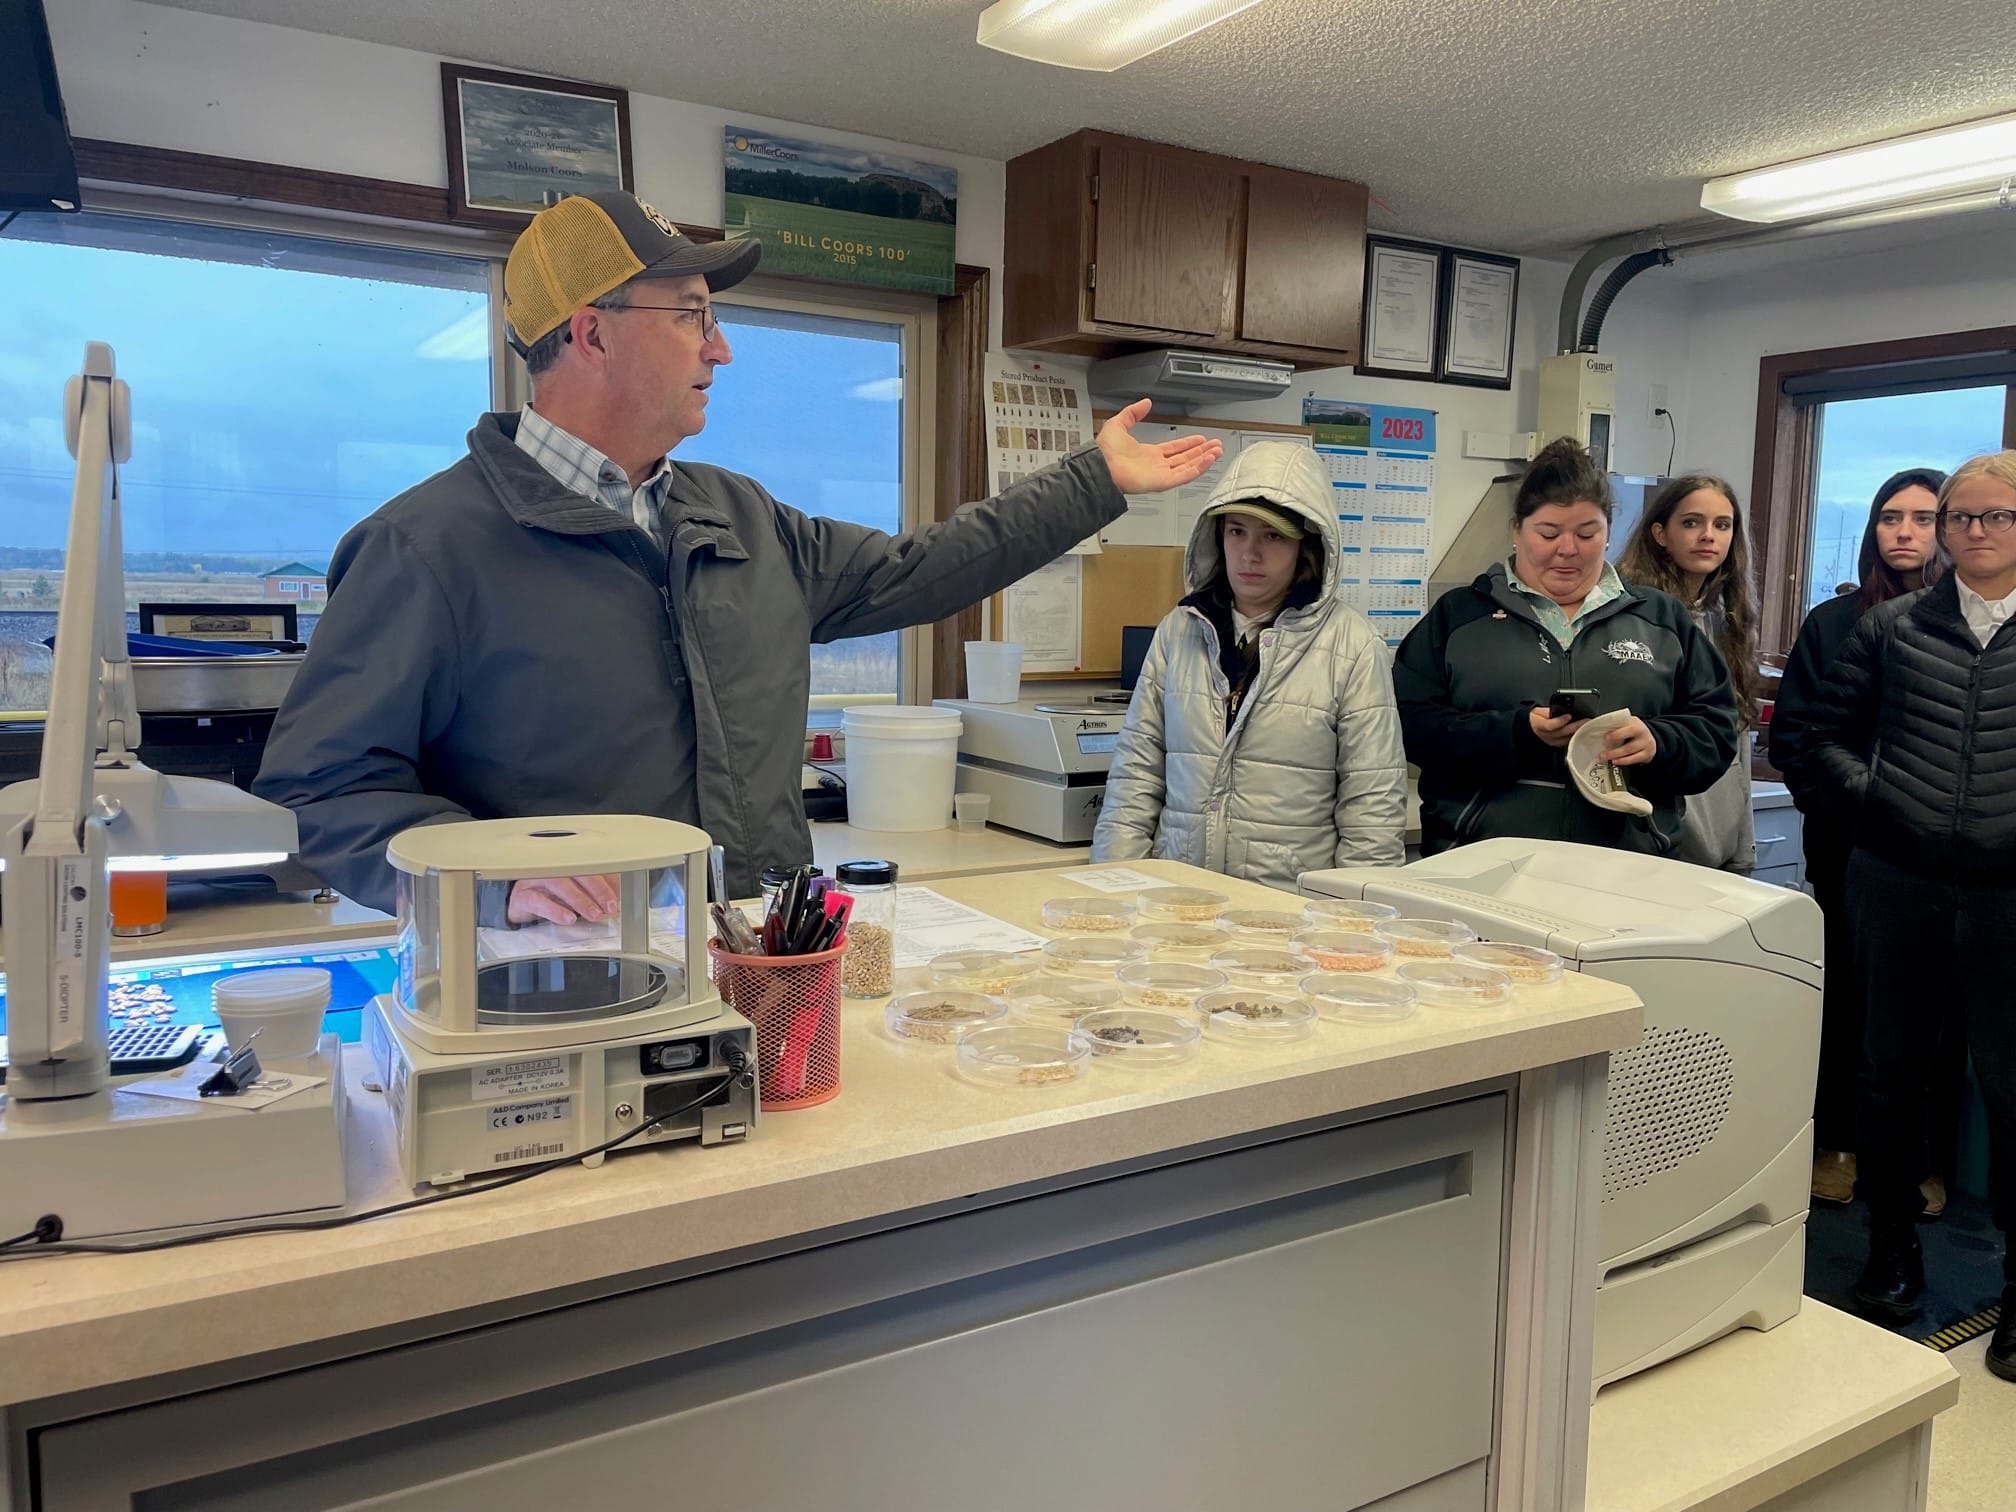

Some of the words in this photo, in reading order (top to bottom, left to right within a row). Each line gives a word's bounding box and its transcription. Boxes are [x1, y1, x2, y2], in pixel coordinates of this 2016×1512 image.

[547, 142, 582, 154] Member
[750, 143, 799, 161] MillerCoors
[506, 160, 548, 174] Molson
[550, 166, 583, 178] Coors
[821, 237, 873, 257] COORS
[833, 253, 857, 265] 2015
[1001, 369, 1021, 381] Stored
[1022, 373, 1048, 384] Product
[1049, 375, 1066, 386] Pests
[1382, 417, 1425, 441] 2023
[491, 1074, 523, 1084] ADAPTER
[508, 1086, 530, 1095] MADE
[540, 1081, 565, 1090] KOREA
[509, 1102, 544, 1112] Company
[545, 1097, 569, 1106] Limited
[527, 1112, 548, 1121] N92
